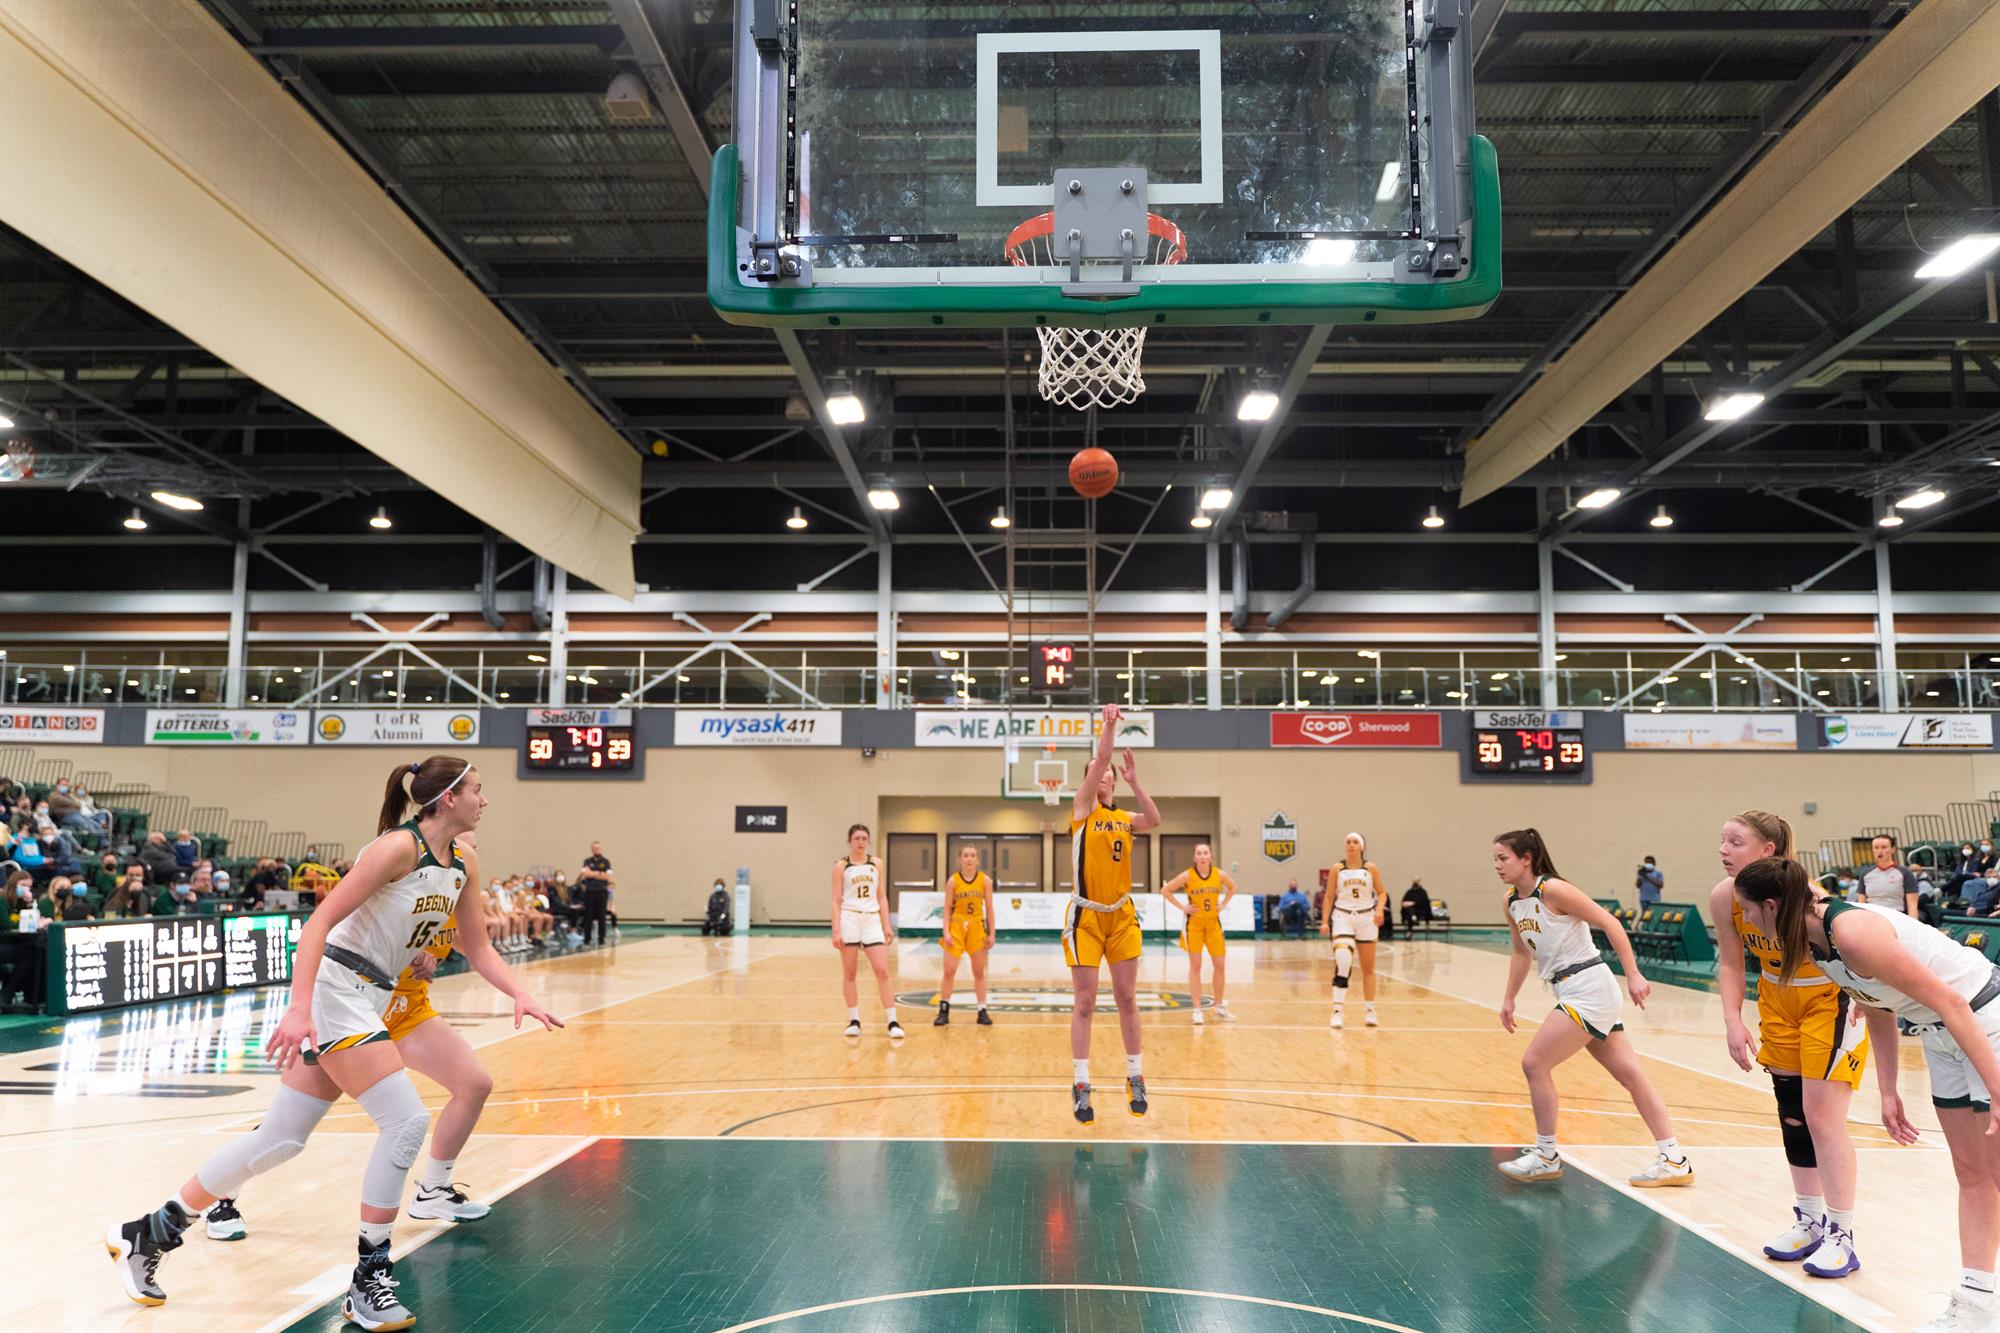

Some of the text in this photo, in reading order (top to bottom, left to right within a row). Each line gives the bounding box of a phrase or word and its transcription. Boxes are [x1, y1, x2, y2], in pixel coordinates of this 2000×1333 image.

[156, 719, 230, 731] LOTTERIES
[375, 713, 420, 725] U of R
[541, 710, 596, 724] SaskTel
[1489, 713, 1546, 726] SaskTel
[371, 728, 424, 741] Alumni
[960, 719, 989, 739] WE
[994, 719, 1036, 737] ARE
[1305, 721, 1347, 732] CO-OP
[1358, 722, 1410, 732] Sherwood
[1516, 731, 1553, 750] 7:40
[530, 739, 553, 760] 50
[608, 739, 631, 760] 23
[1479, 743, 1502, 763] 50
[1560, 743, 1583, 763] 23
[591, 751, 602, 768] 3
[1543, 755, 1554, 771] 3
[1112, 840, 1123, 863] 9
[857, 885, 870, 898] 12
[1352, 888, 1360, 899] 5
[405, 920, 440, 949] 15
